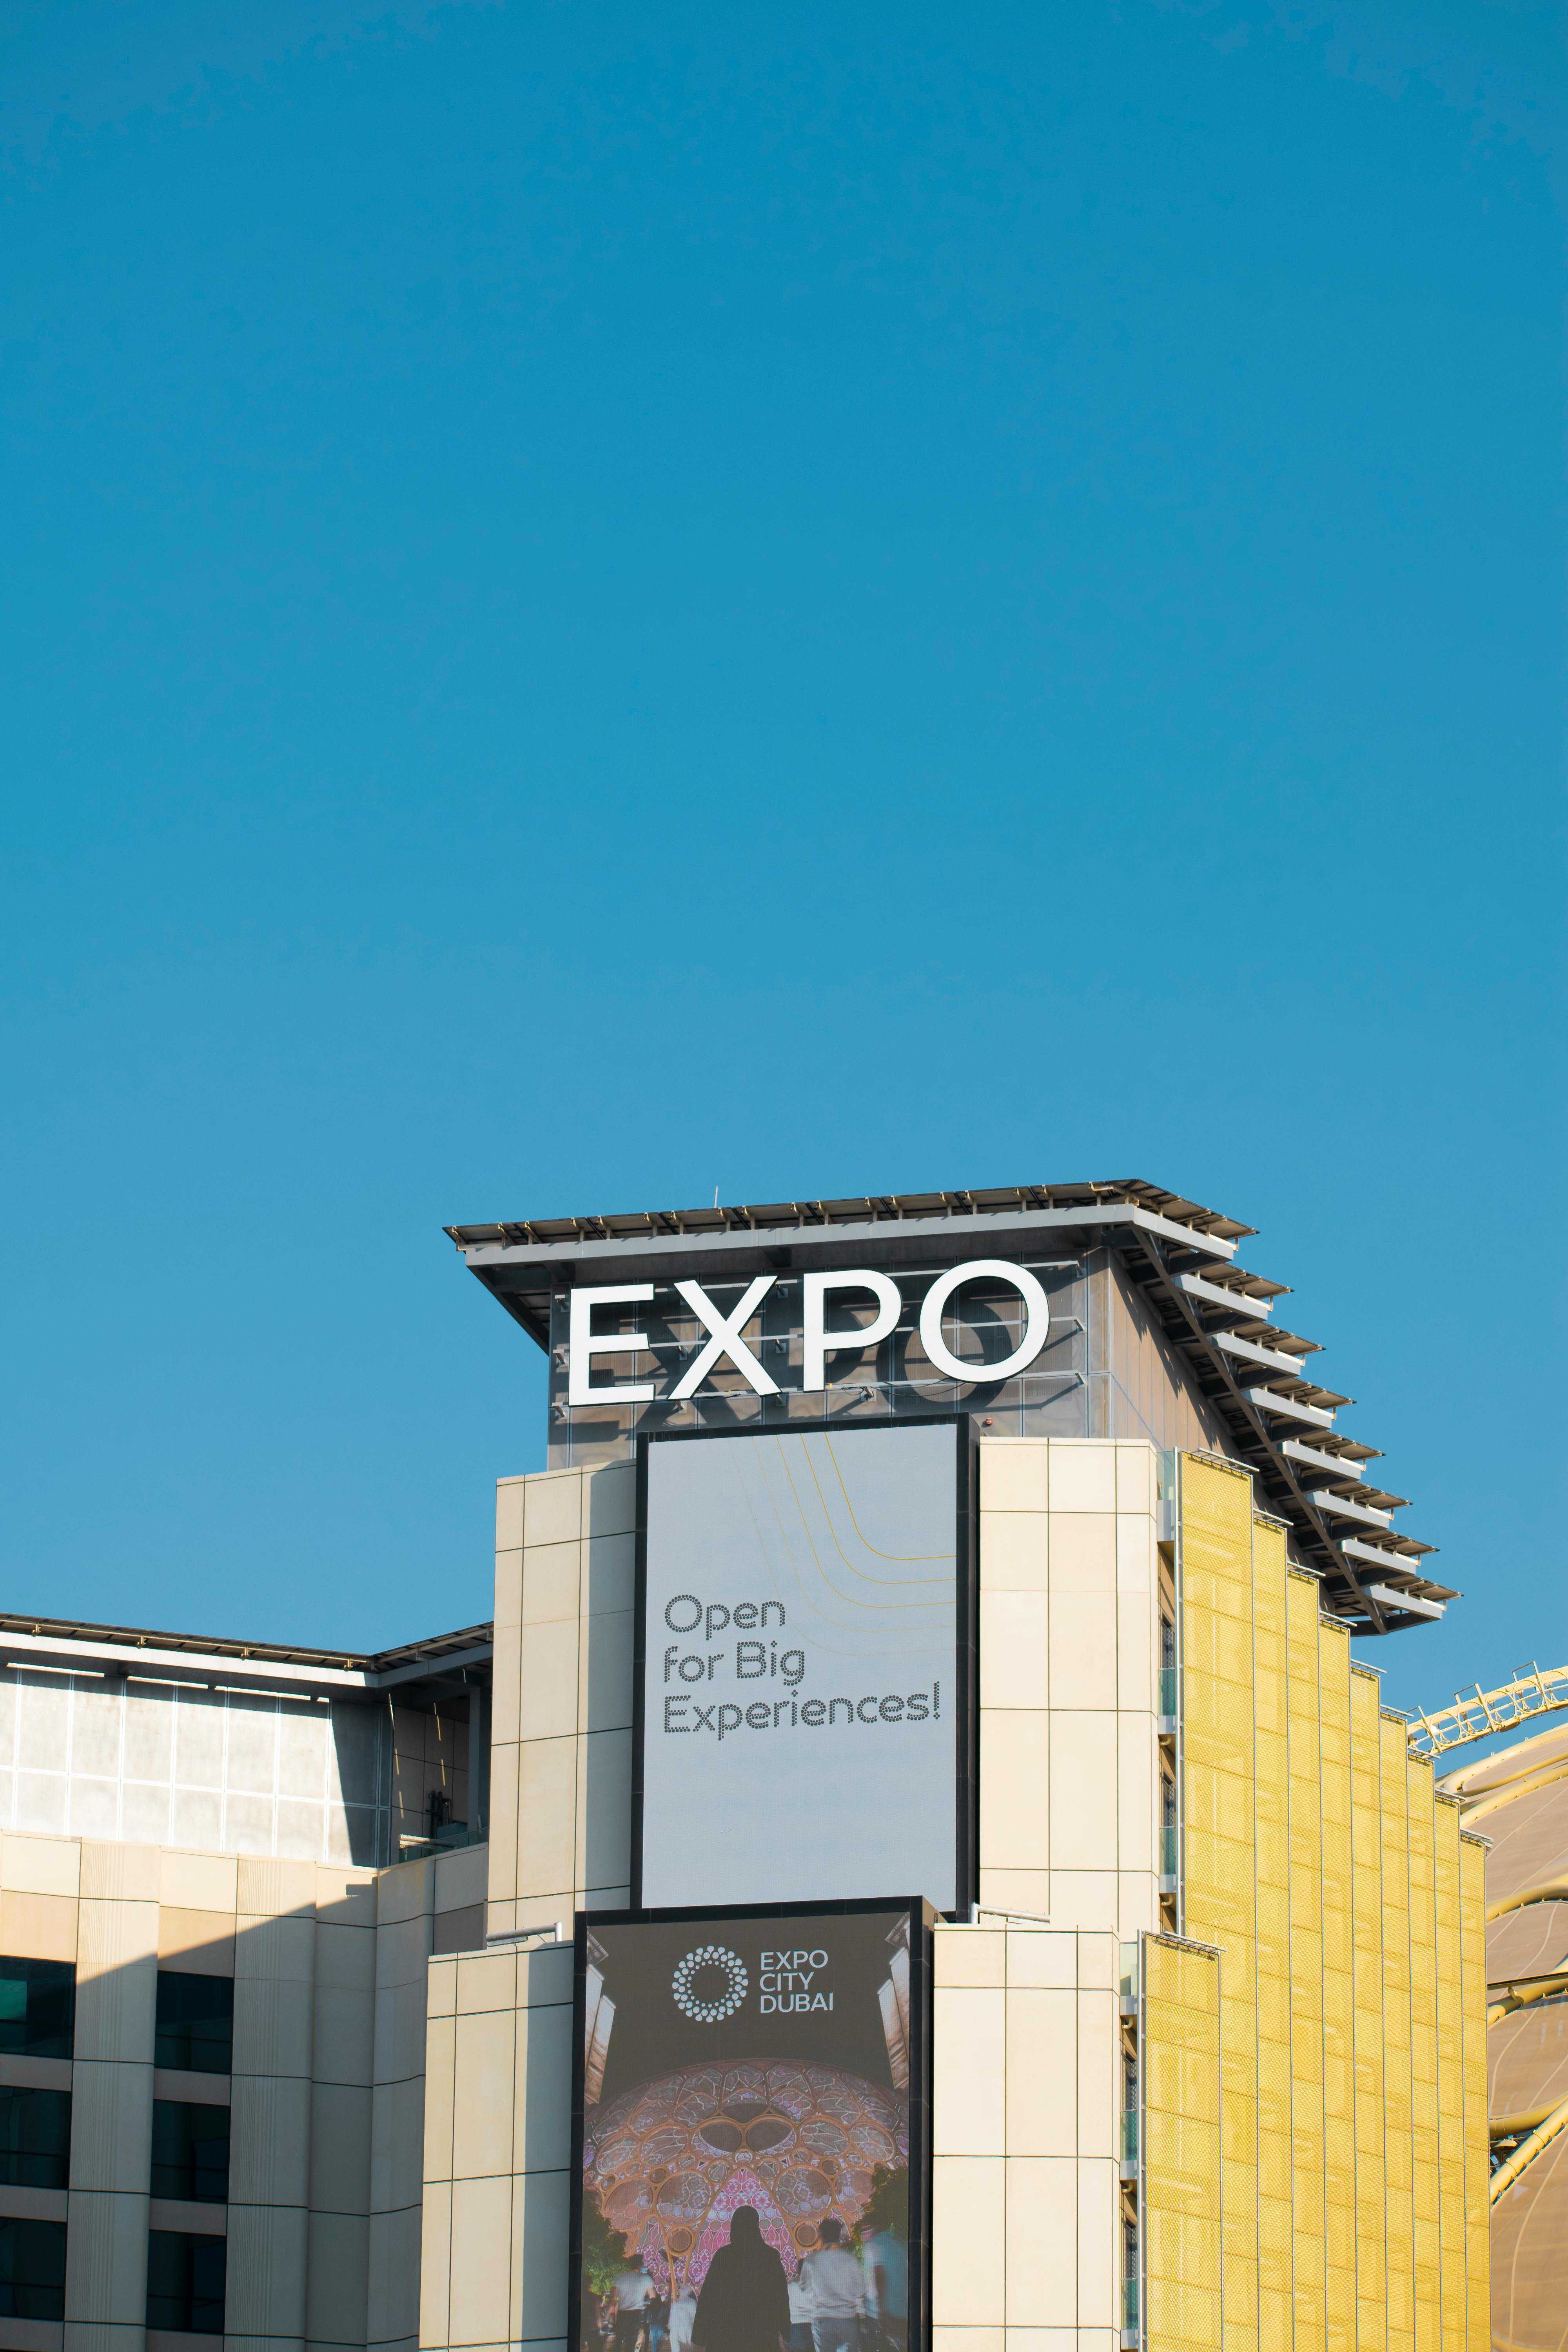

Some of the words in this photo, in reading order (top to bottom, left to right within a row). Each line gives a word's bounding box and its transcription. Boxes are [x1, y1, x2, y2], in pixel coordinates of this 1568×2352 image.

[569, 1259, 1049, 1406] EXPO
[664, 1594, 786, 1641] Open
[664, 1646, 724, 1683] for
[736, 1640, 805, 1686] Big
[664, 1681, 940, 1740] Experiences!
[760, 1949, 828, 1970] EXPO
[760, 1971, 815, 1992] CITY
[760, 1992, 833, 2013] DUBAI
